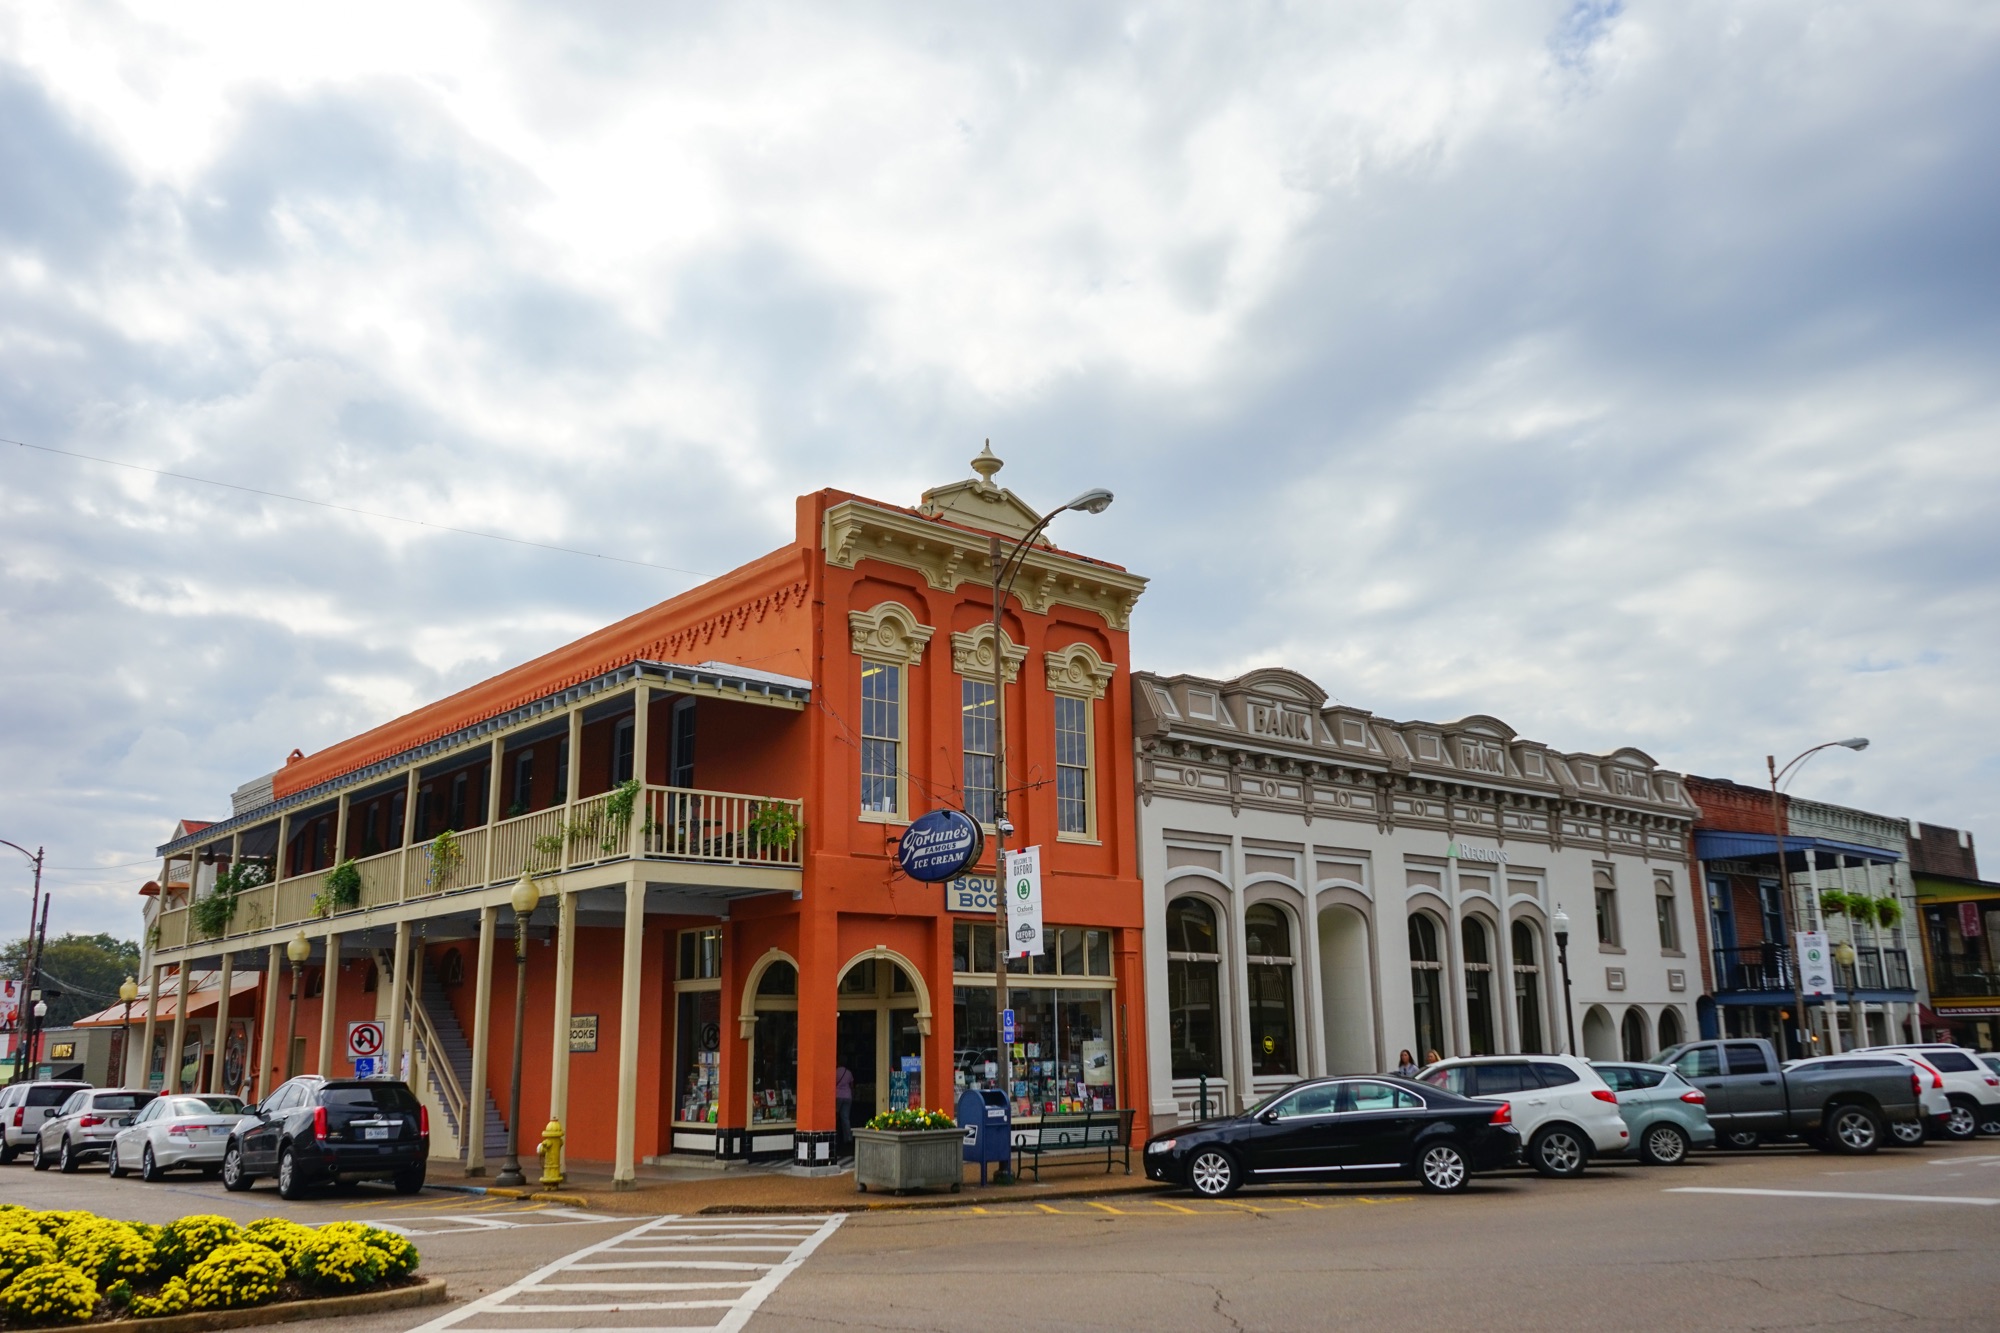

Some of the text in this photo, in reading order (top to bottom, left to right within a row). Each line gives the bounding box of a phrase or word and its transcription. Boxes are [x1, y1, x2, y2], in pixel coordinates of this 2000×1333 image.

[1253, 705, 1310, 740] BANK
[1462, 745, 1503, 774] BANK
[1613, 775, 1648, 798] BANK
[902, 824, 969, 866] Fortune's
[924, 842, 957, 854] FAMOUS
[1460, 843, 1508, 863] REGIONS
[913, 851, 965, 870] ICE CREAM
[1013, 863, 1033, 877] OXFORD
[1016, 904, 1034, 913] Oxford
[1016, 929, 1036, 939] OXFORD
